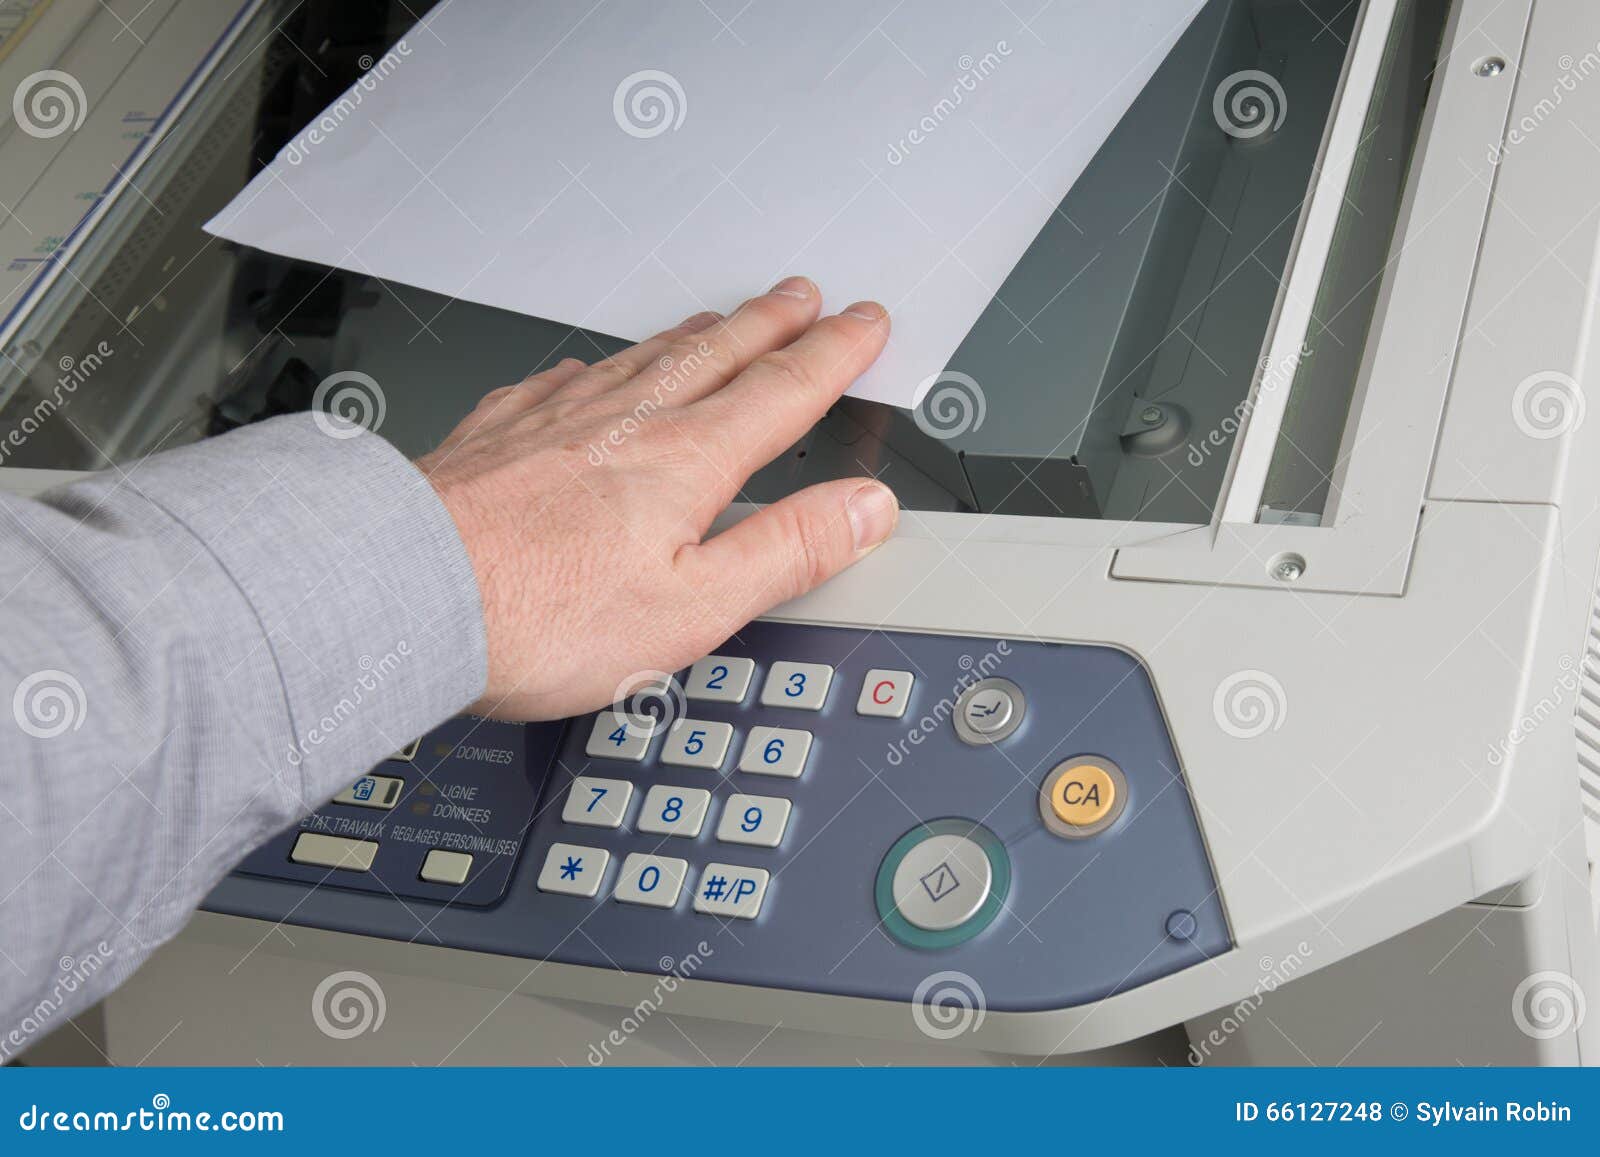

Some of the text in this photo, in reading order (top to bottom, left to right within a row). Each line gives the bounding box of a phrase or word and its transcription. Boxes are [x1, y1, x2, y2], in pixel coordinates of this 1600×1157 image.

[707, 665, 729, 689] 2
[784, 672, 806, 698] 3
[871, 679, 896, 705] C
[608, 724, 628, 747] 4
[684, 731, 706, 756] 5
[456, 746, 514, 765] DONNEES
[763, 738, 785, 765] 6
[441, 784, 478, 801] LIGNE
[588, 787, 608, 812] 7
[1062, 781, 1100, 807] CA
[433, 804, 491, 824] DONNEES
[661, 796, 684, 823] 8
[741, 806, 763, 833] 9
[334, 817, 387, 838] TRAVAUX
[391, 825, 519, 856] REGLAGES PERSONNALISES
[638, 865, 661, 893] 0
[703, 875, 757, 904] #/P
